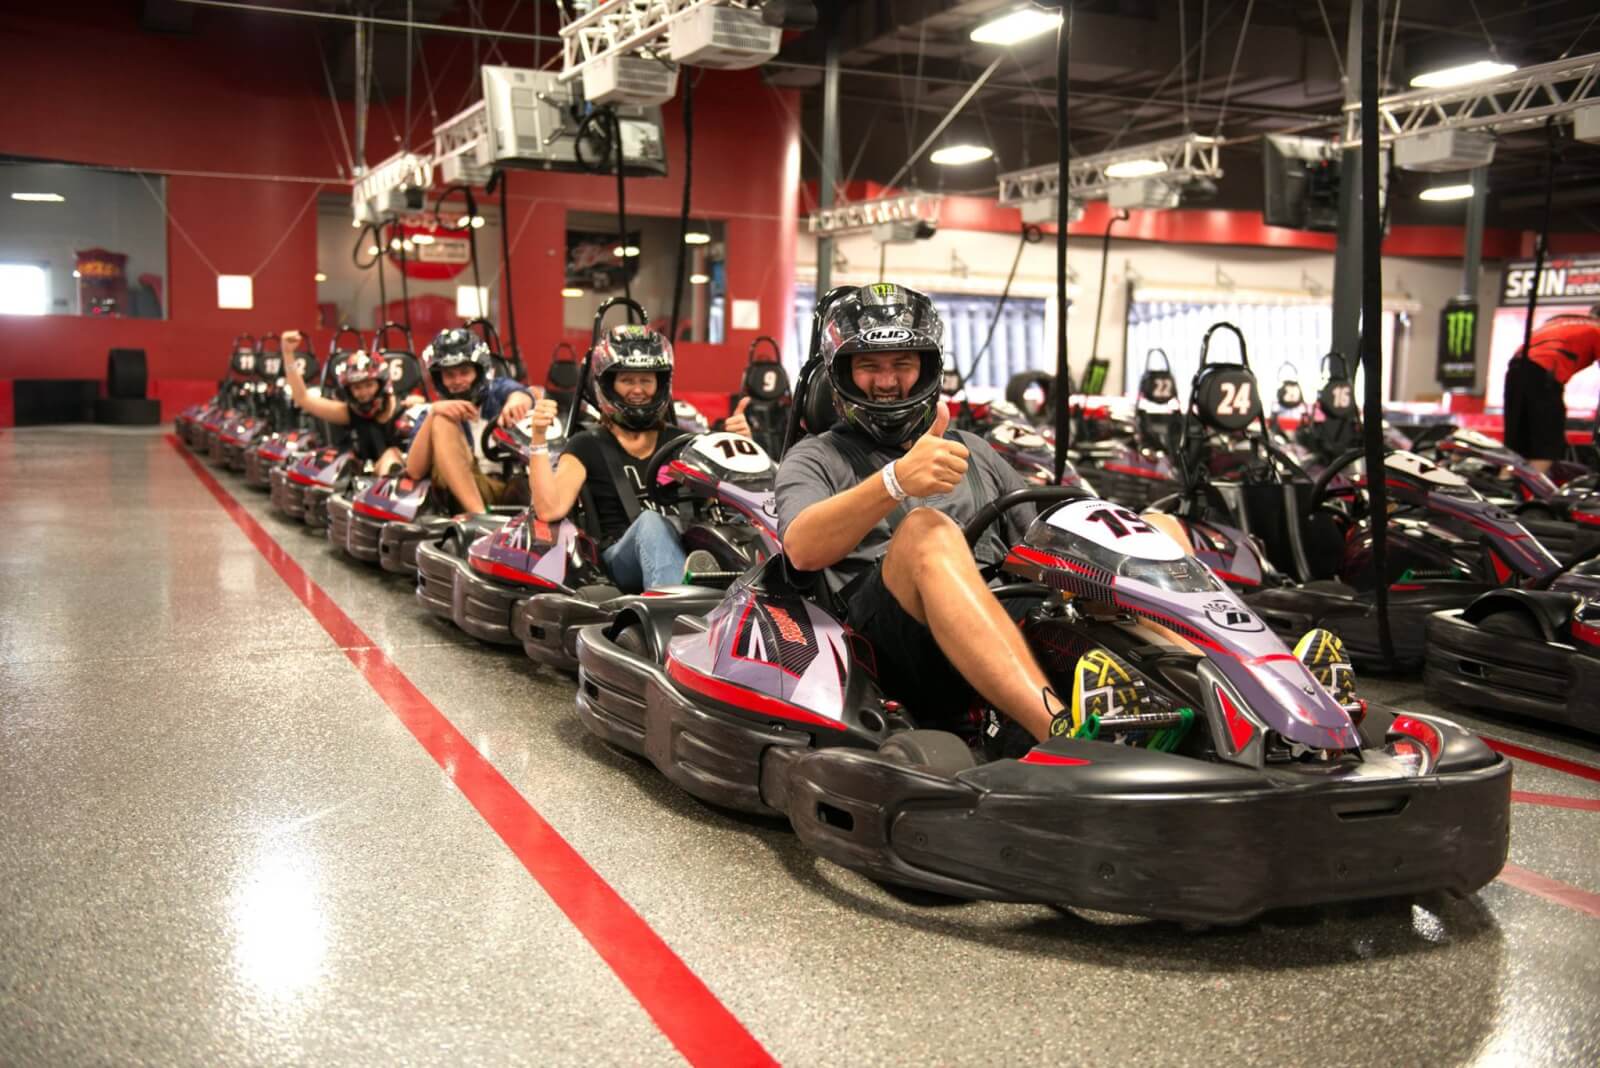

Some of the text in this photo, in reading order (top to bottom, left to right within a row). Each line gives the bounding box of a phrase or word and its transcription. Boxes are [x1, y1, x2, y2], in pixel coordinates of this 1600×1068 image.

[868, 330, 905, 340] HJC
[390, 358, 403, 381] 6
[763, 371, 777, 392] 9
[1152, 378, 1172, 397] 22
[1216, 382, 1251, 415] 24
[713, 439, 759, 459] 10
